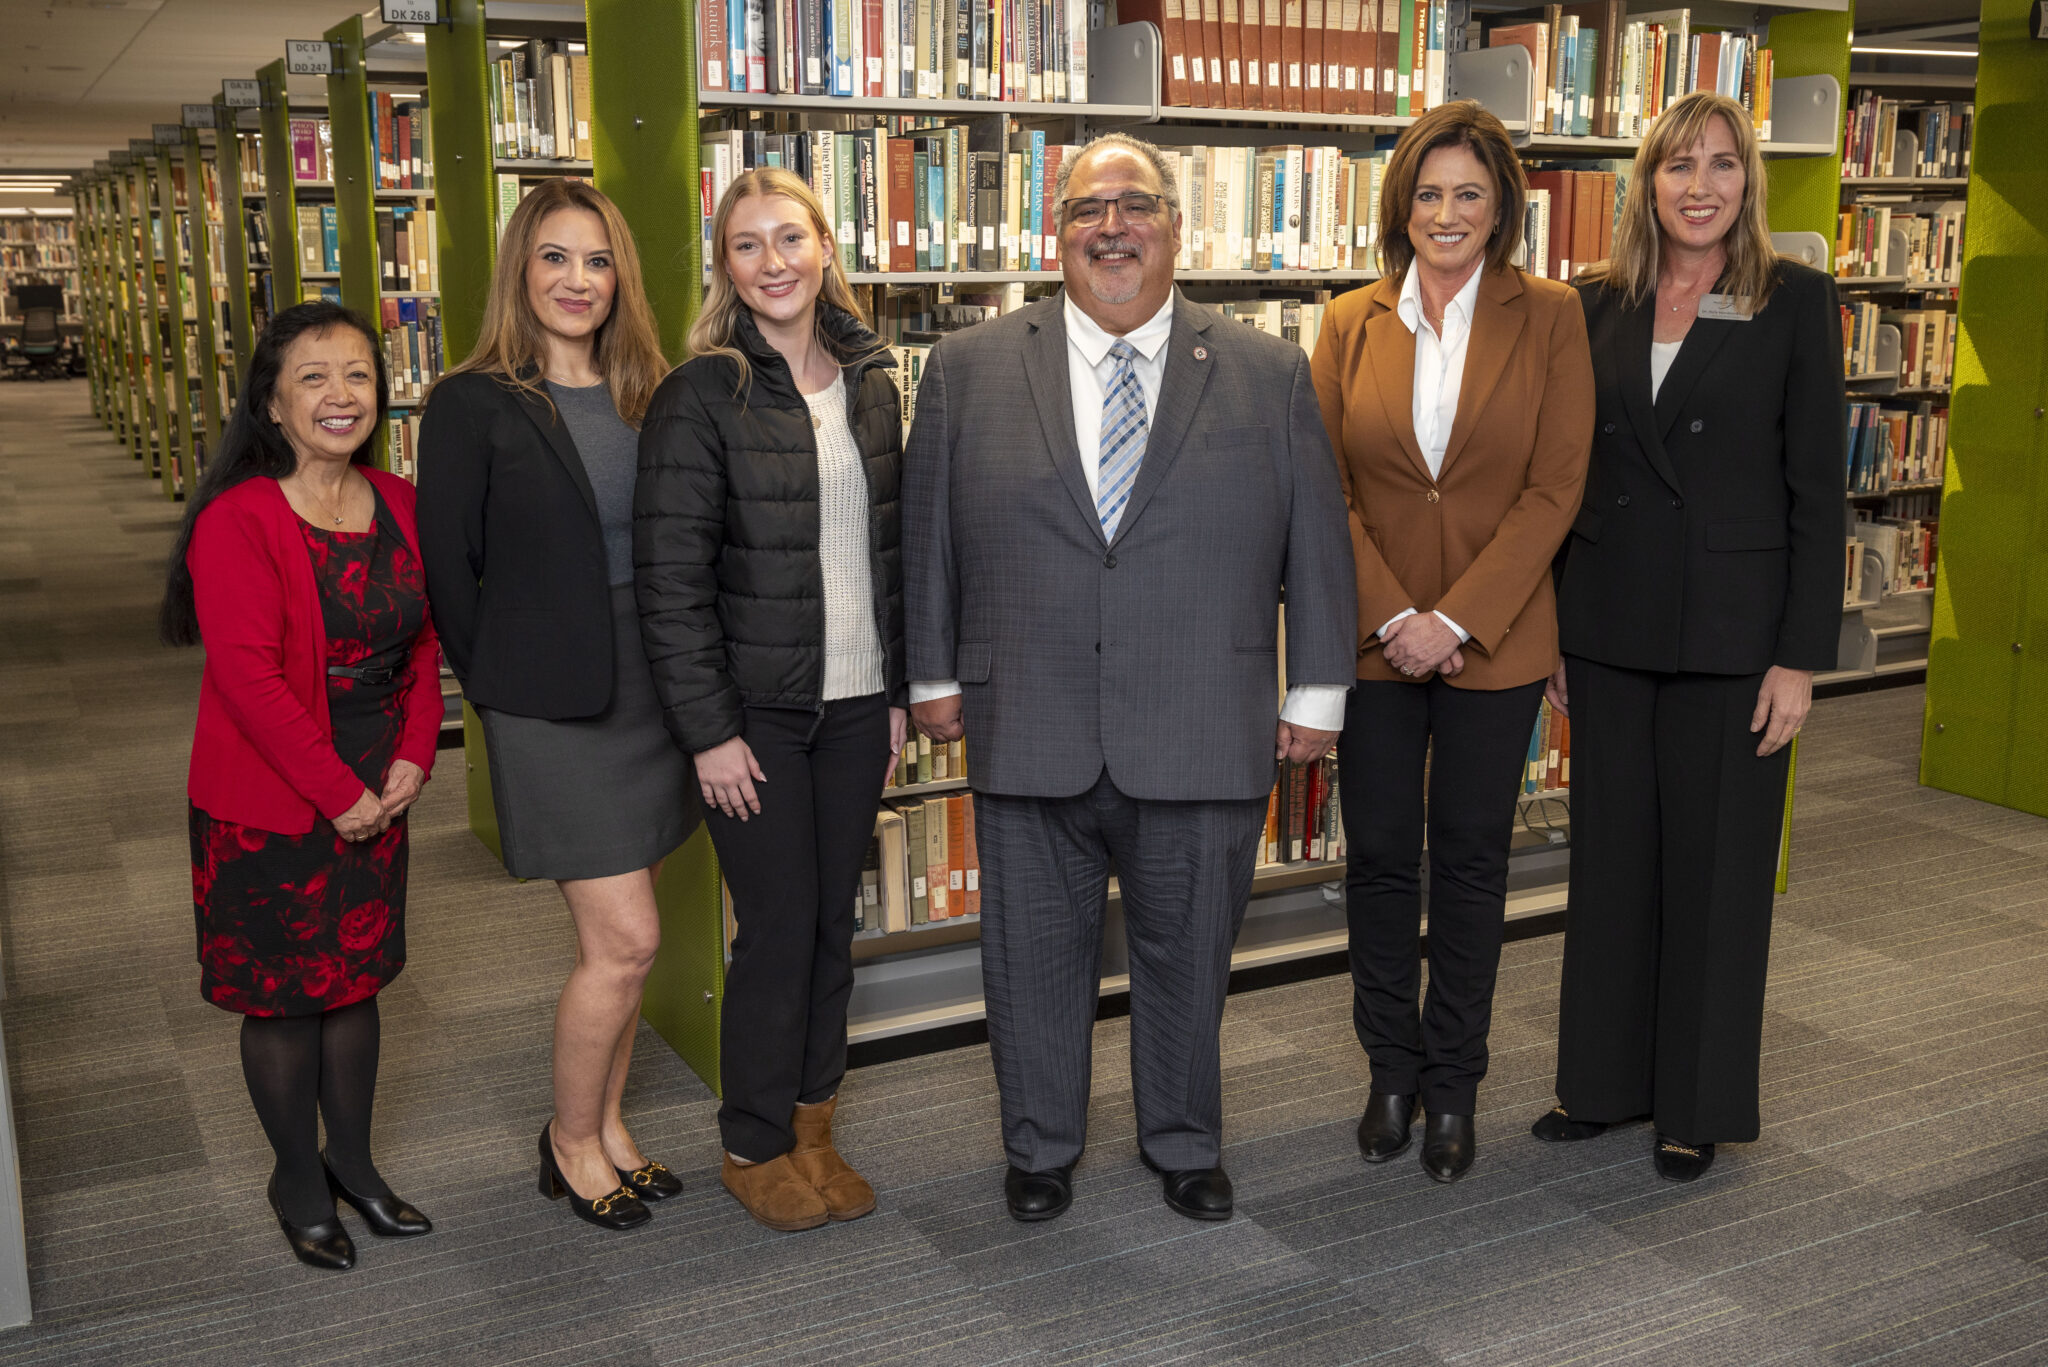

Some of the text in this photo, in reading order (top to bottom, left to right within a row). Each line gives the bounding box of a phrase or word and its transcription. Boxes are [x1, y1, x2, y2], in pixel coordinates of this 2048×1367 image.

[391, 9, 431, 21] DK 268
[296, 44, 322, 52] DC 17
[1028, 19, 1036, 73] HOLBROOK
[295, 64, 327, 72] DD 247
[821, 132, 832, 195] Peking to Paris
[865, 154, 874, 184] GREAT
[1371, 163, 1381, 186] ARAB
[842, 154, 851, 223] MONSOON AS
[1035, 182, 1043, 212] KHAN
[1293, 157, 1301, 209] KINGMAKERS
[866, 186, 875, 226] RAILWAY
[902, 394, 910, 421] China?
